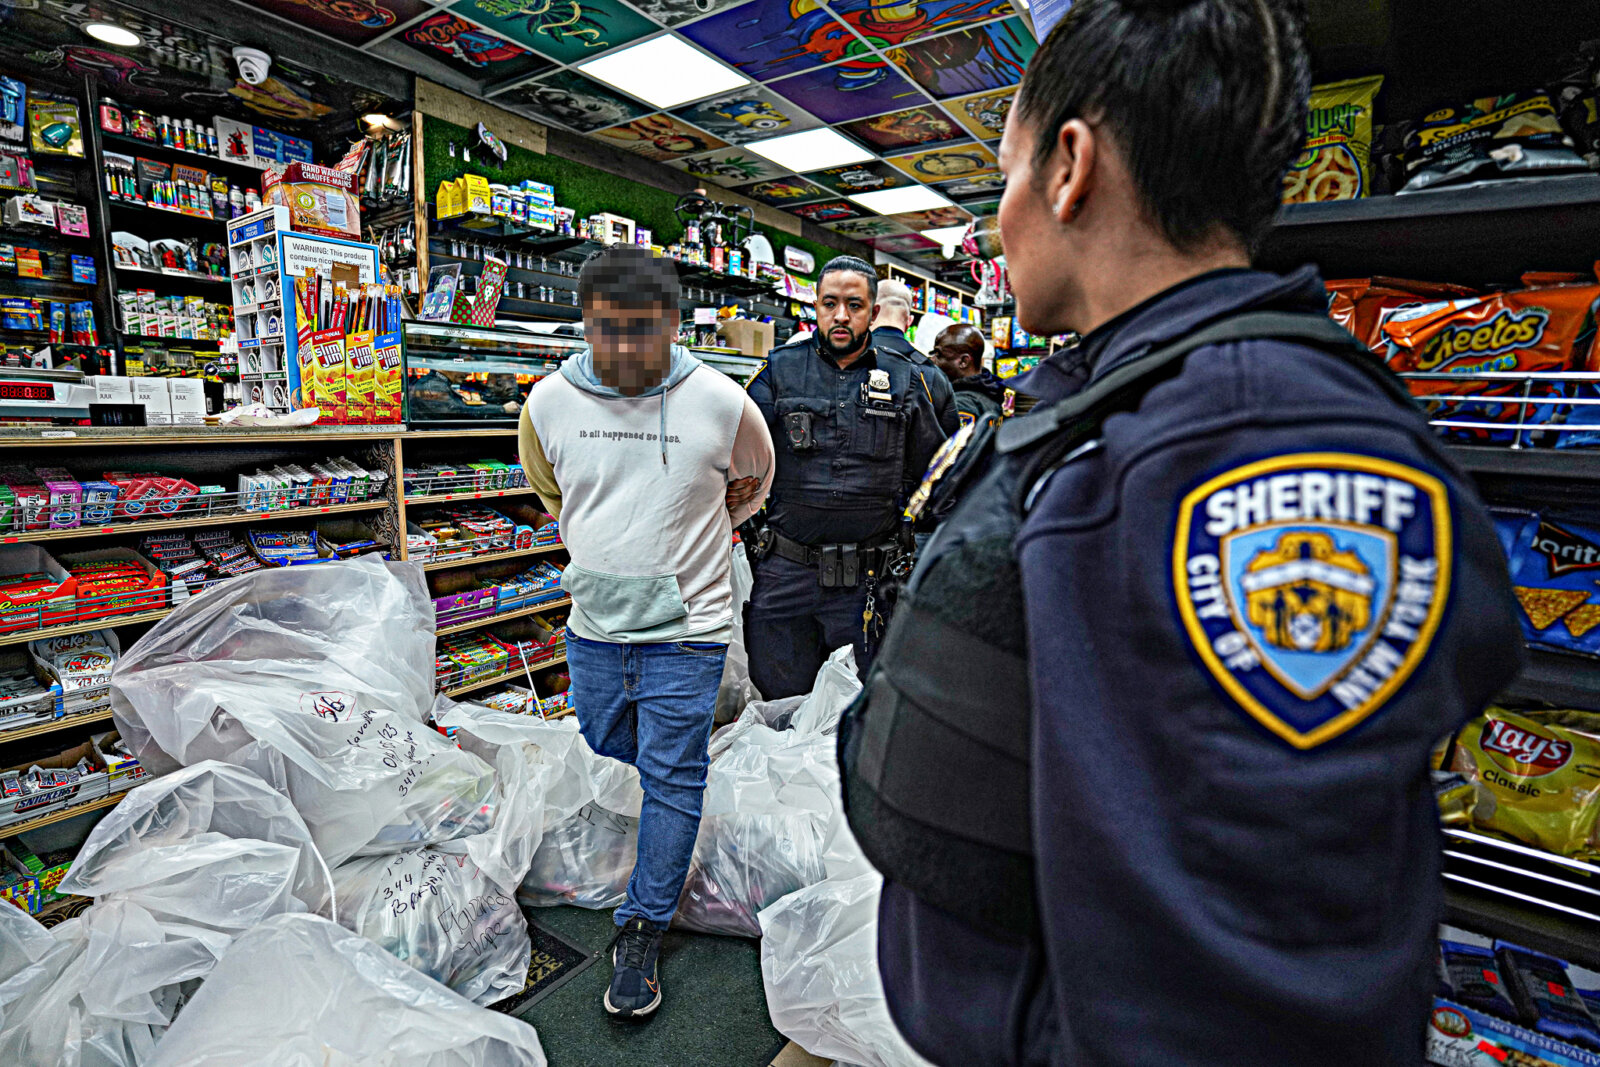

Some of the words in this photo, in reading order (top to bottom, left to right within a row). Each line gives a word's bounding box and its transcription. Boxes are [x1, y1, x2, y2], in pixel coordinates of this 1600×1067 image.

[301, 163, 320, 175] HAND
[321, 167, 352, 181] WARMERS
[302, 171, 352, 188] CHAUFFE-MAINS
[290, 253, 317, 263] contains
[292, 242, 329, 255] WARNING:
[330, 248, 343, 257] This
[343, 250, 367, 261] product
[1416, 311, 1541, 371] Cheetos
[579, 430, 588, 438] It
[589, 430, 600, 438] all
[602, 430, 644, 441] happened
[1205, 472, 1416, 536] SHERIFF
[256, 535, 293, 546] Almond
[294, 534, 309, 545] Joy
[1531, 535, 1600, 564] orit
[1187, 554, 1230, 619] CITY
[1214, 631, 1261, 671] OF
[1384, 555, 1438, 641] YORK
[1484, 721, 1567, 764] Lay's
[1483, 769, 1541, 797] Classic
[18, 787, 72, 808] SNICKERS
[383, 873, 413, 900] 344
[1489, 1020, 1511, 1034] NO
